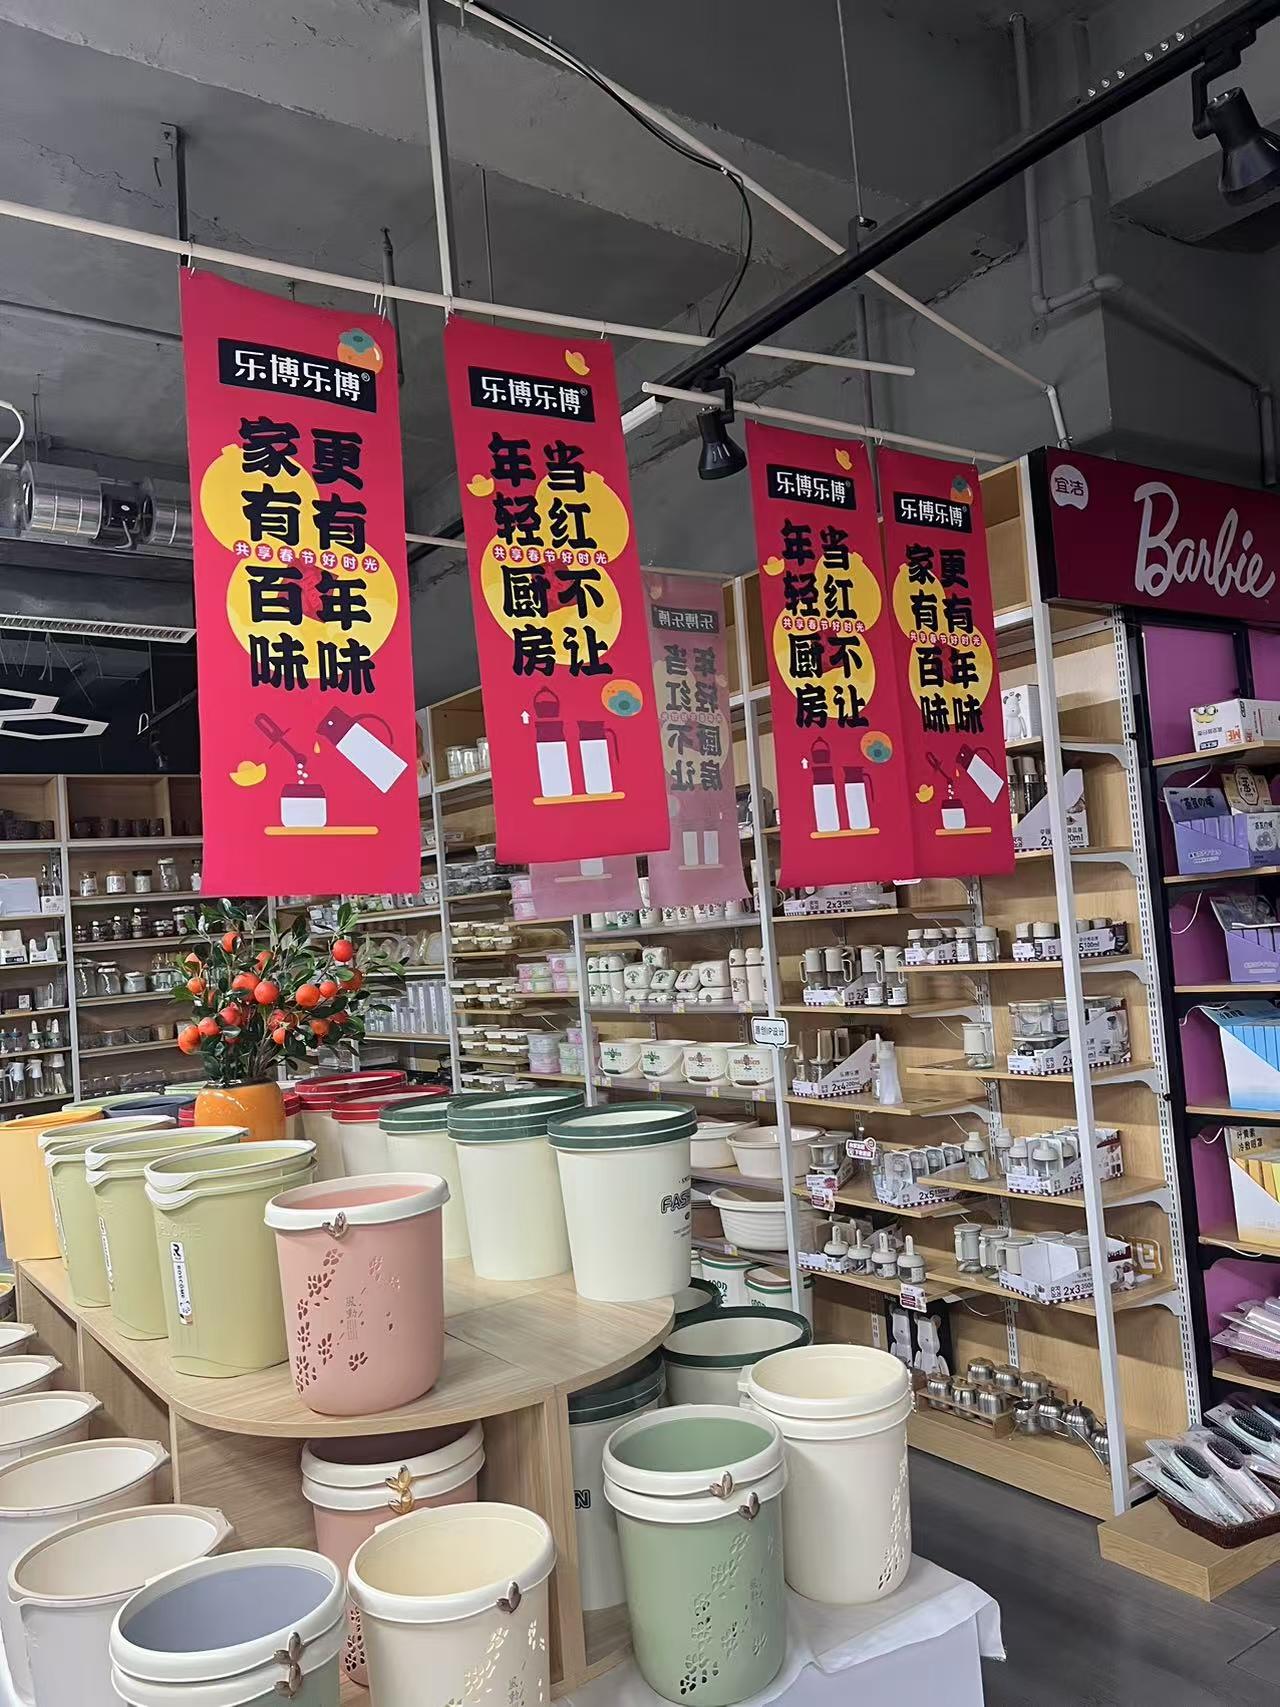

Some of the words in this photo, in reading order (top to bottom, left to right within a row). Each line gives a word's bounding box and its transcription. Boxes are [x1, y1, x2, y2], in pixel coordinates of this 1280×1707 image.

[233, 540, 380, 574] 共享春节好时光
[238, 416, 309, 692] 家有百味
[311, 428, 376, 696] 更有年味
[488, 431, 556, 677] 年轻厨房
[543, 439, 613, 677] 当红不让
[1055, 477, 1084, 497] 宜洁
[1133, 481, 1276, 598] Barbie
[781, 518, 828, 729] 年轻厨房
[820, 525, 869, 729] 当红不让
[905, 543, 951, 733] 家有百味
[939, 548, 985, 734] 更有年味
